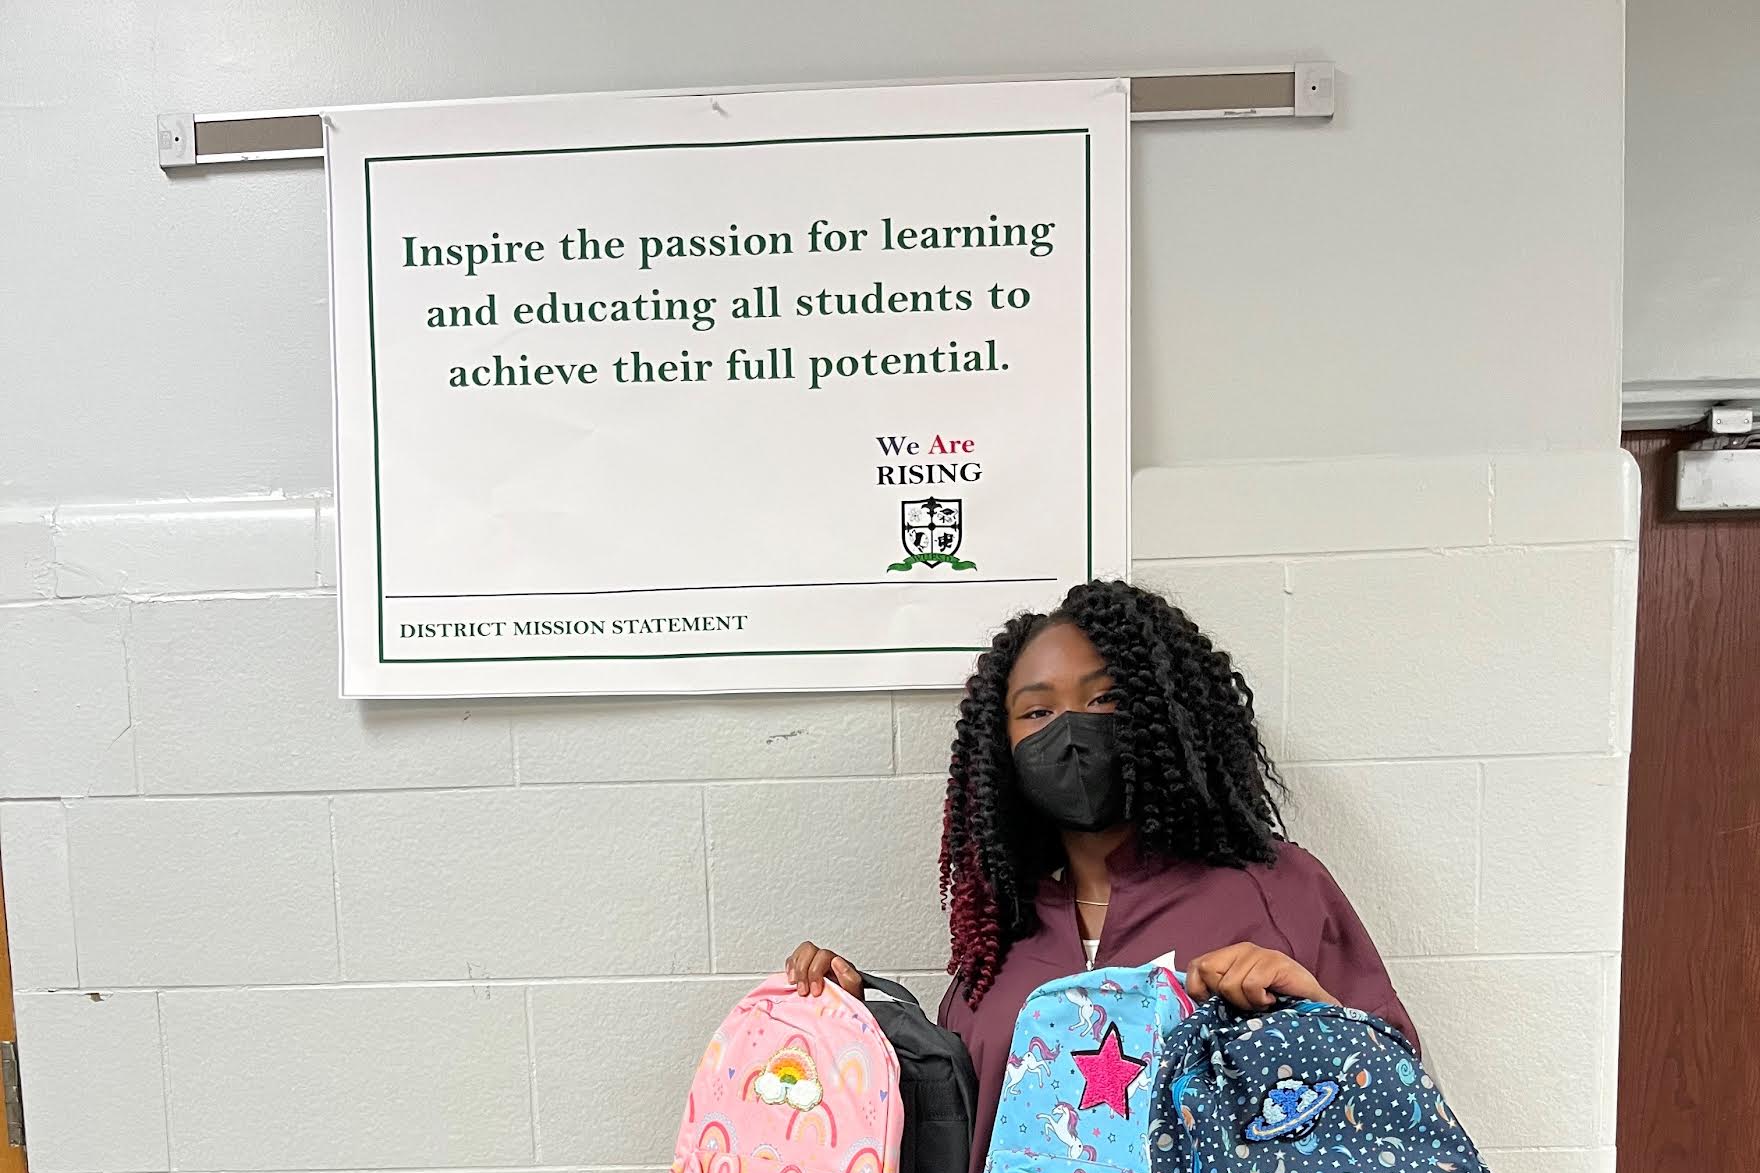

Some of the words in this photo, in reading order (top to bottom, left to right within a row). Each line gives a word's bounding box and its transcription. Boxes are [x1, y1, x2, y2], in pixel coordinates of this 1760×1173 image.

[402, 232, 545, 277] Inspire
[558, 227, 625, 261] the
[638, 223, 794, 271] passion
[807, 219, 868, 253] for
[880, 214, 1056, 258] learning
[427, 293, 498, 328] and
[513, 288, 717, 332] educating
[731, 285, 782, 319] all
[796, 281, 973, 317] students
[987, 282, 1031, 310] to
[449, 354, 598, 388] achieve
[612, 350, 713, 383] their
[726, 347, 796, 381] full
[808, 339, 1009, 390] potential.
[876, 435, 920, 457] We
[927, 434, 975, 455] Are
[876, 462, 983, 486] RISING
[400, 621, 507, 639] DISTRICT
[513, 619, 606, 637] MISSION
[612, 615, 748, 635] STATEMENT
